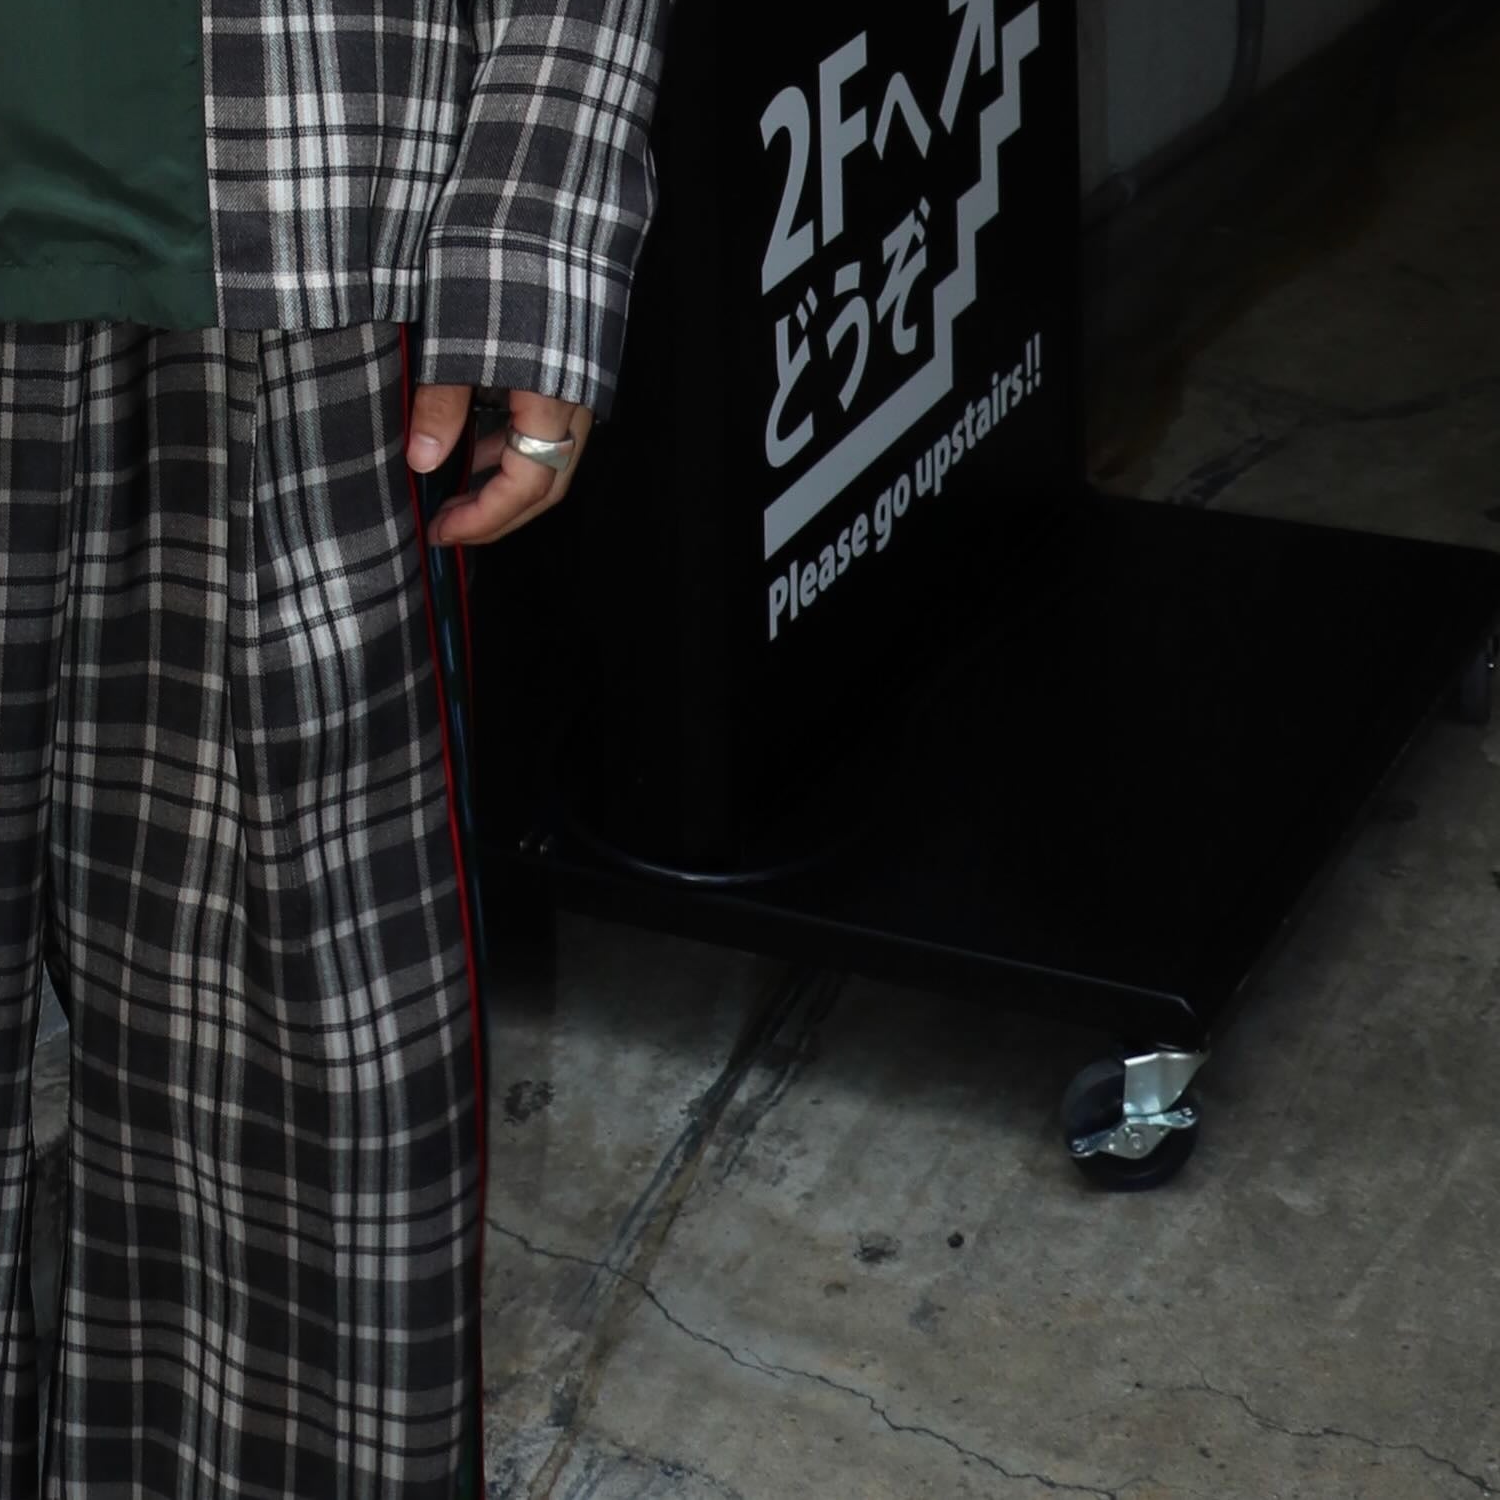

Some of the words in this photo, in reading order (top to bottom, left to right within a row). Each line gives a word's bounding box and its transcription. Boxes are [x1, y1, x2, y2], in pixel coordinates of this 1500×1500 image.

[765, 195, 931, 469] どうぞ
[768, 512, 869, 642] Please
[873, 473, 911, 553] go
[915, 330, 1042, 498] upstairs!!
